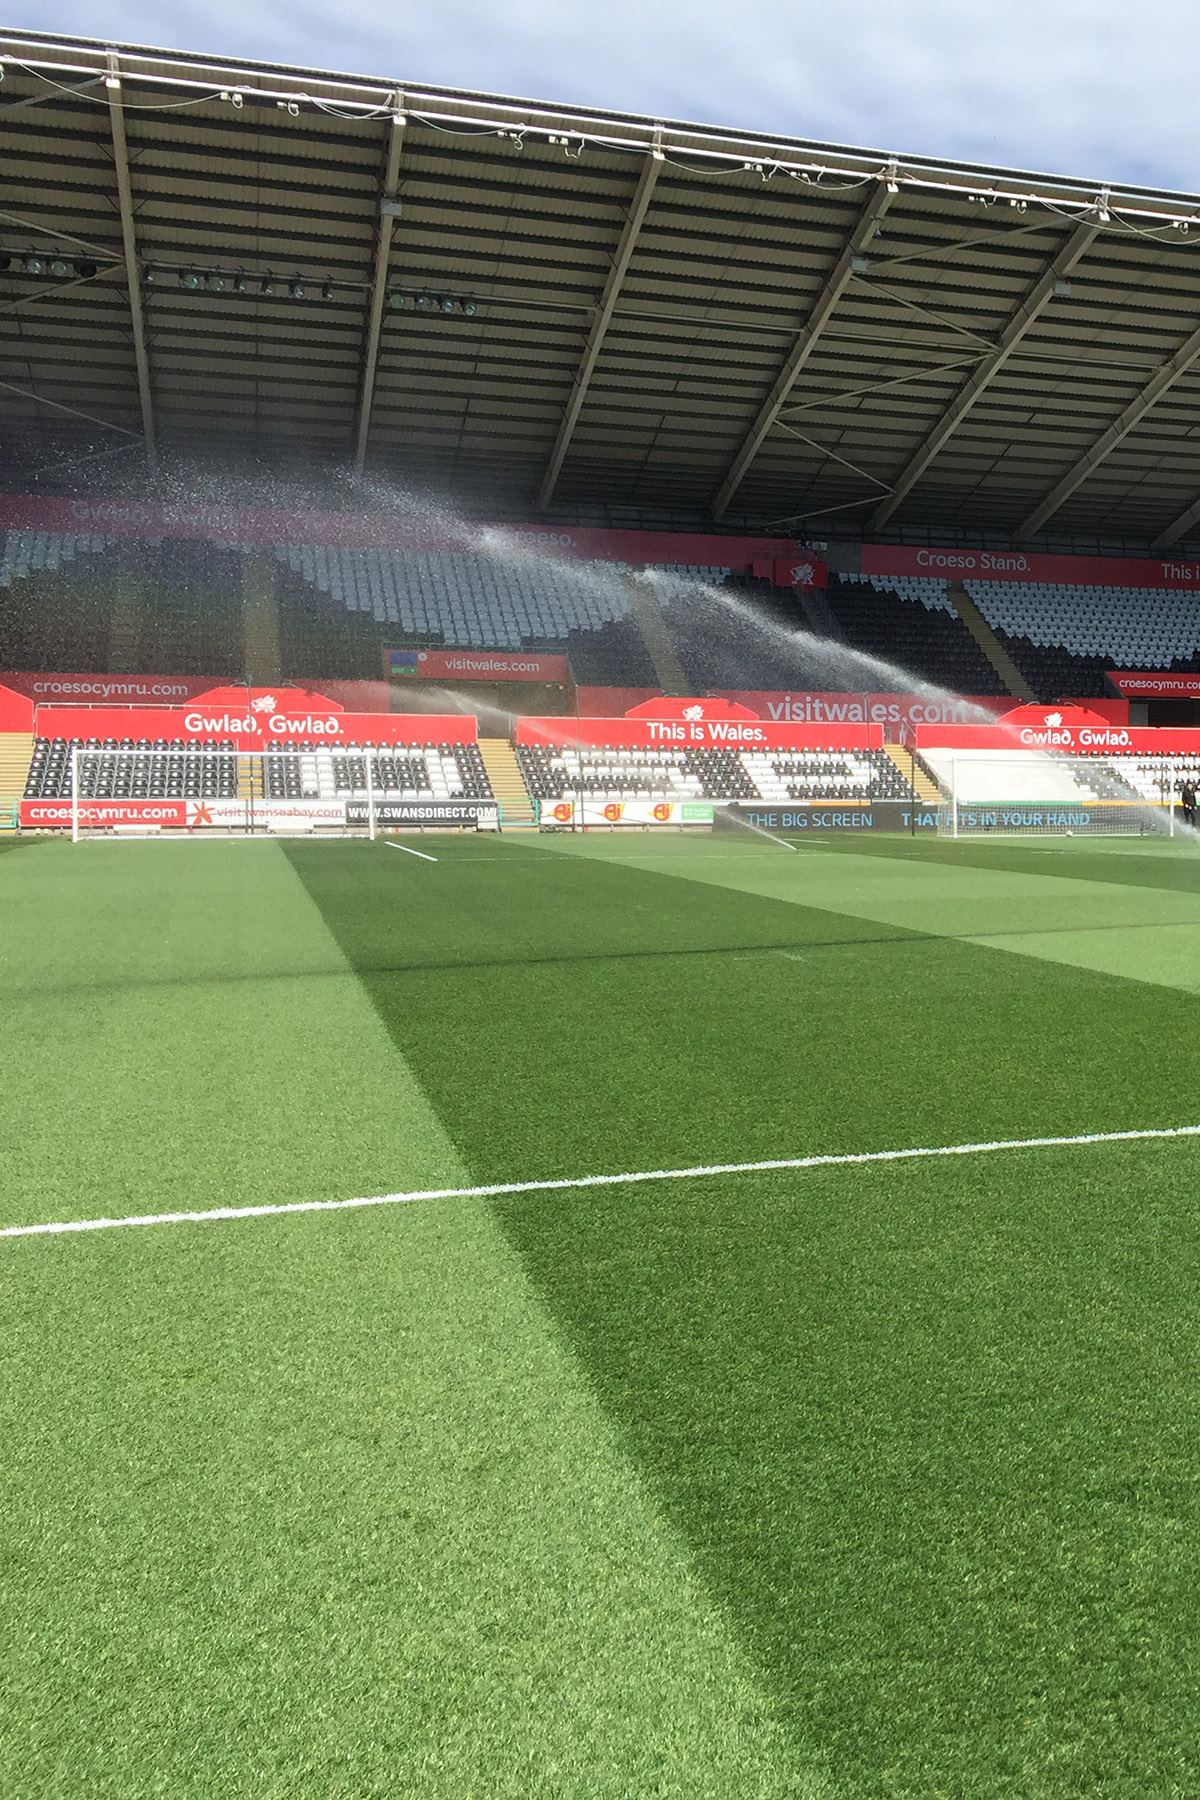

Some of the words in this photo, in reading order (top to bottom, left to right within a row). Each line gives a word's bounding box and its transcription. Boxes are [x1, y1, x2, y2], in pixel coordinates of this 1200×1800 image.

[916, 550, 977, 569] Croeso
[1161, 563, 1193, 580] This
[445, 657, 540, 673] visitwales.com
[33, 681, 188, 697] croesocymru.com
[767, 695, 967, 723] visitwaes.com
[646, 722, 686, 740] This
[690, 724, 704, 740] is
[708, 723, 768, 741] Wales.
[747, 813, 777, 827] THE
[782, 813, 808, 827] BIG
[812, 813, 873, 827] SCREEN
[946, 813, 978, 826] FTS
[1002, 813, 1043, 826] YOUR
[1046, 812, 1091, 826] HAND
